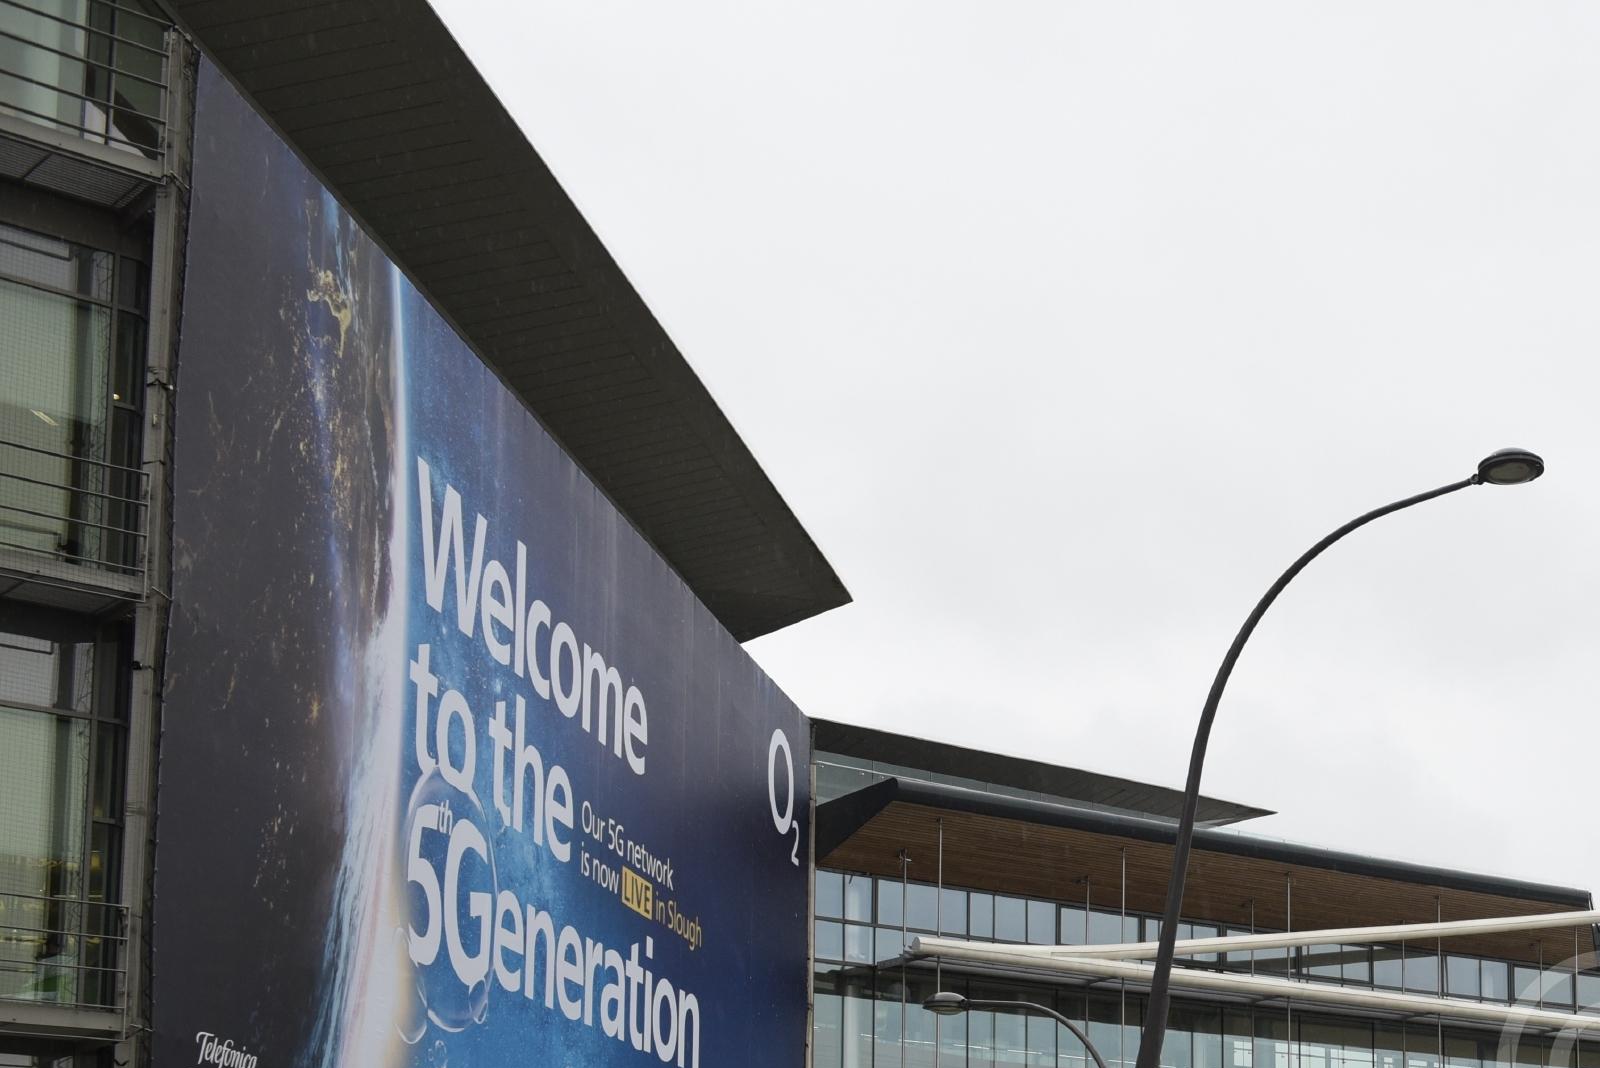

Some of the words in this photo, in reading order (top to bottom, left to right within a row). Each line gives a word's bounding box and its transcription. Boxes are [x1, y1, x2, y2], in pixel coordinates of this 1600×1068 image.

[417, 456, 648, 775] Welcome
[410, 644, 476, 793] to
[489, 696, 574, 863] the
[581, 800, 606, 843] Our
[608, 818, 624, 857] 5G
[627, 839, 674, 891] network
[581, 841, 590, 877] is
[592, 858, 619, 894] now
[624, 871, 650, 915] LIVE
[655, 891, 666, 925] in
[667, 900, 702, 951] Slough
